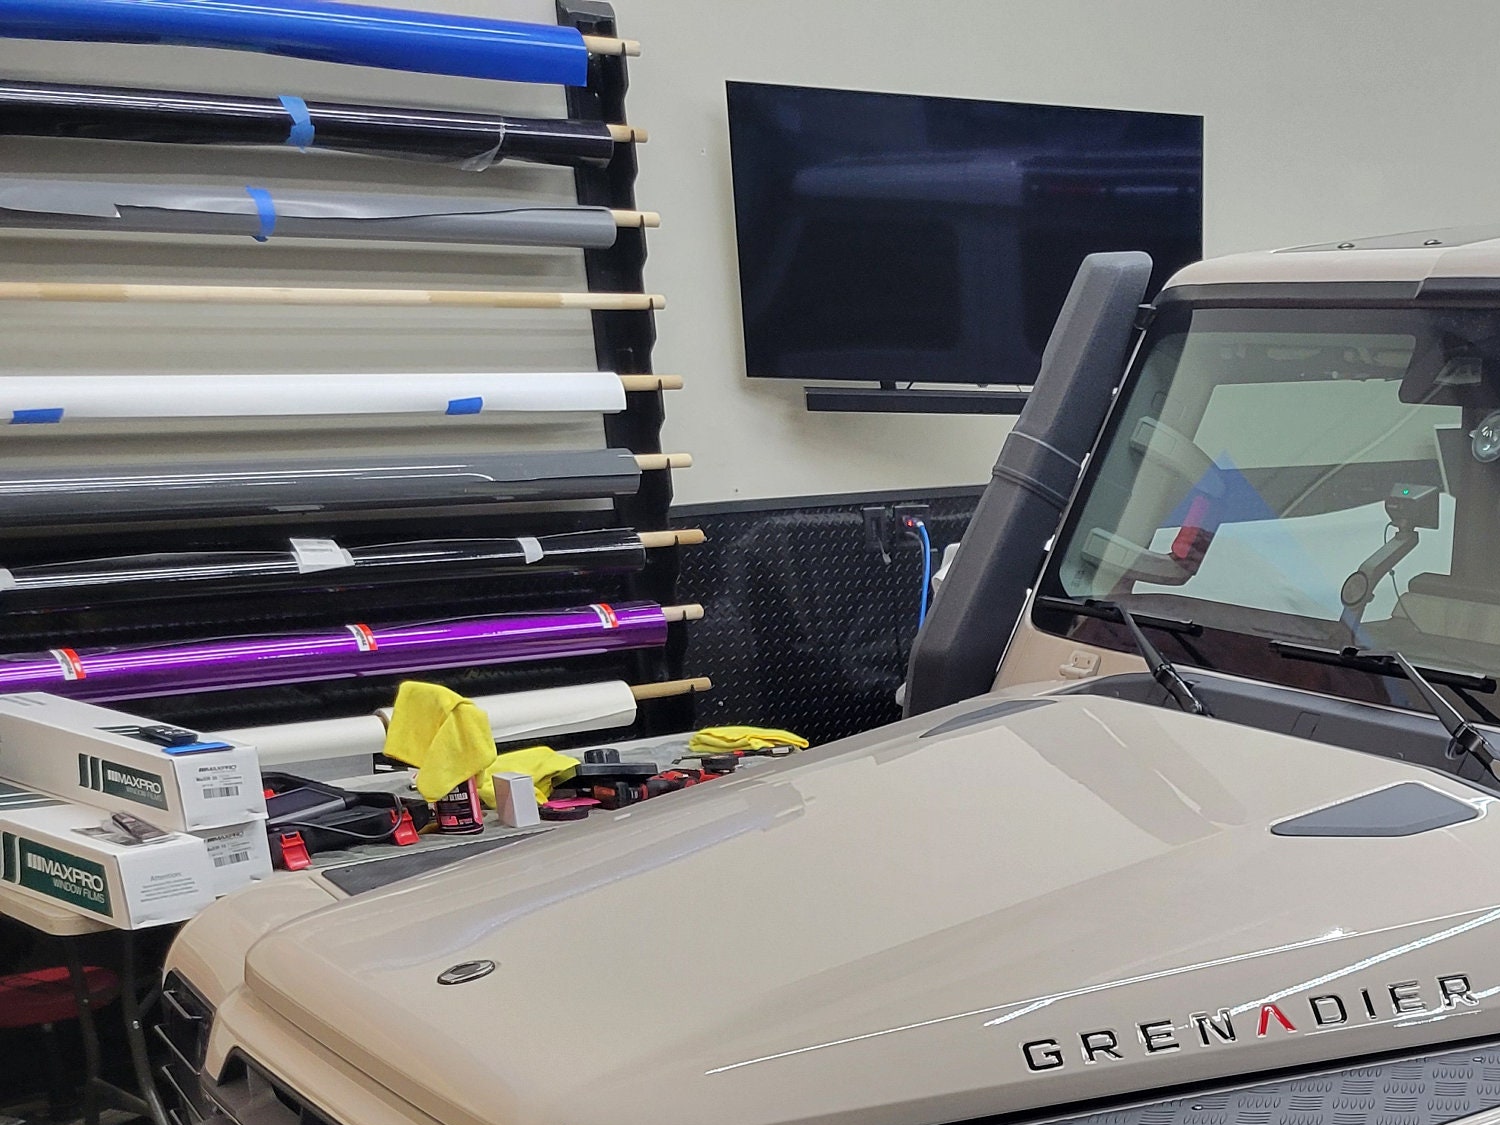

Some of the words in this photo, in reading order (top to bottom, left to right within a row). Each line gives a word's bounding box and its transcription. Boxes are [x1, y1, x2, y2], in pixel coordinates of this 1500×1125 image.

[118, 772, 162, 794] MAXPRO
[42, 858, 104, 892] MAXPRO
[53, 877, 82, 896] WINDOW
[83, 888, 105, 904] FILMS
[1020, 972, 1479, 1073] GRENADIER
